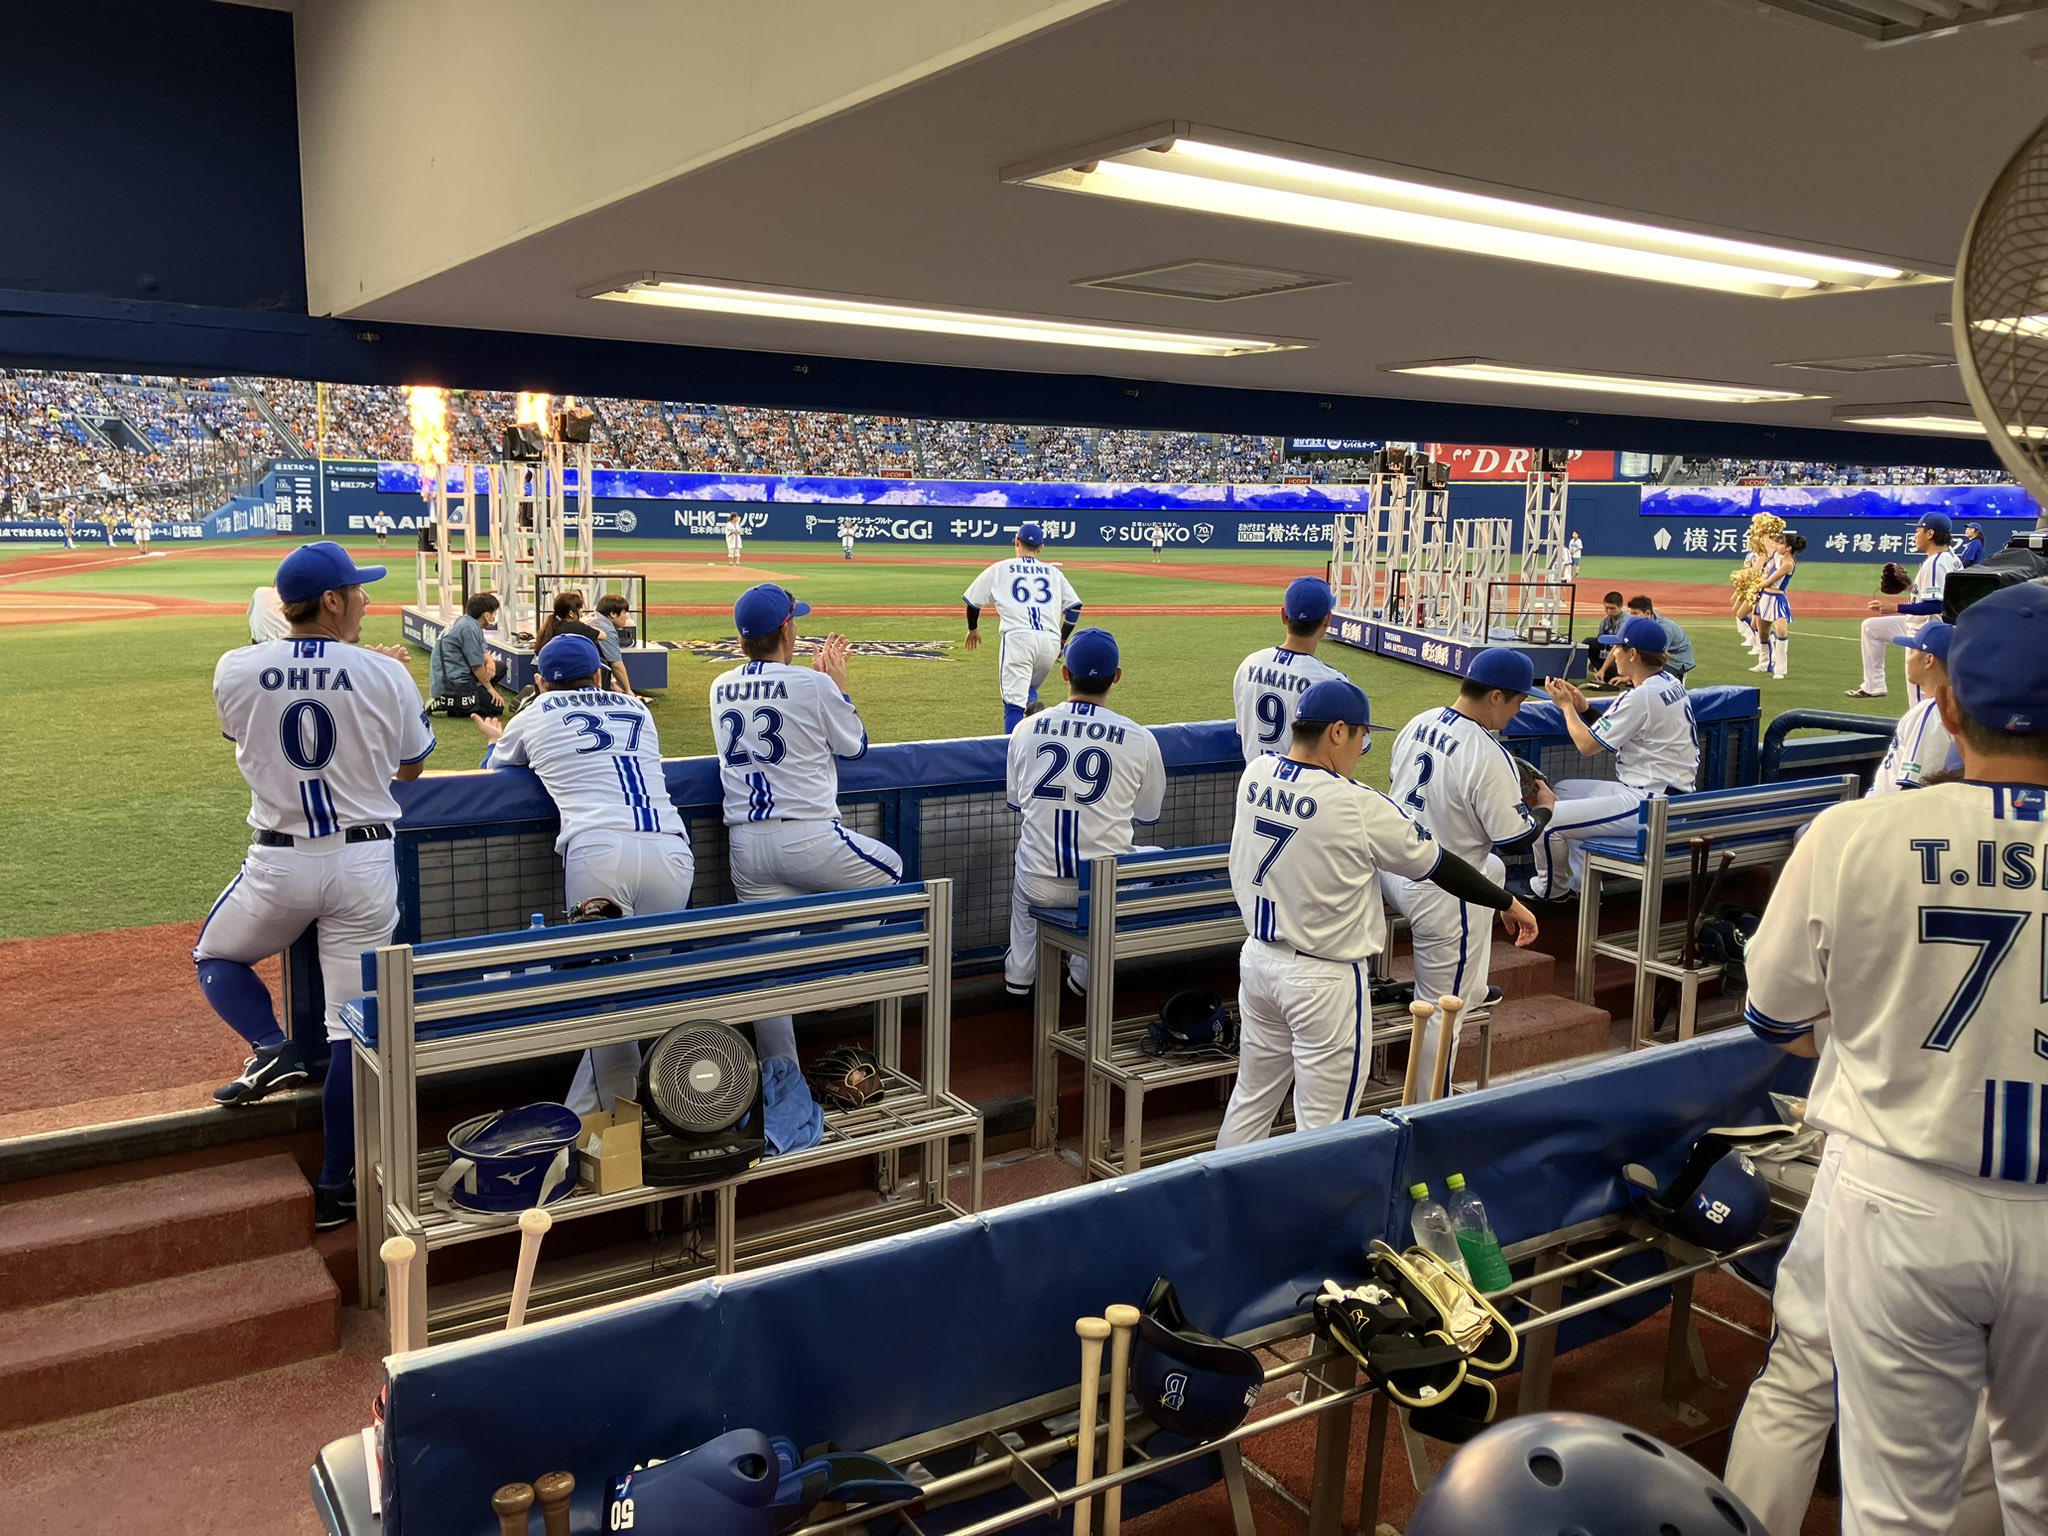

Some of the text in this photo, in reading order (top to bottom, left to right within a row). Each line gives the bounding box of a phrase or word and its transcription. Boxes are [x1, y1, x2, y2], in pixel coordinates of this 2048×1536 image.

[950, 519, 1076, 540] キリン 一搾り
[1825, 533, 1903, 553] 崎陽軒
[1009, 564, 1051, 575] SEKINE
[1011, 577, 1052, 603] 63
[259, 667, 353, 691] OHTA
[716, 680, 789, 704] FUJITA
[279, 698, 337, 770] 0
[562, 710, 645, 753] 37
[1032, 718, 1126, 745] H.ITOH
[1255, 692, 1286, 744] 9
[720, 706, 787, 768] 23
[1411, 723, 1461, 758] MAKI
[1031, 741, 1113, 805] 29
[1405, 751, 1435, 812] 2
[1246, 781, 1318, 820] SANO
[1252, 816, 1299, 887] 7
[1910, 838, 2048, 891] T.IS
[610, 1498, 634, 1531] 50
